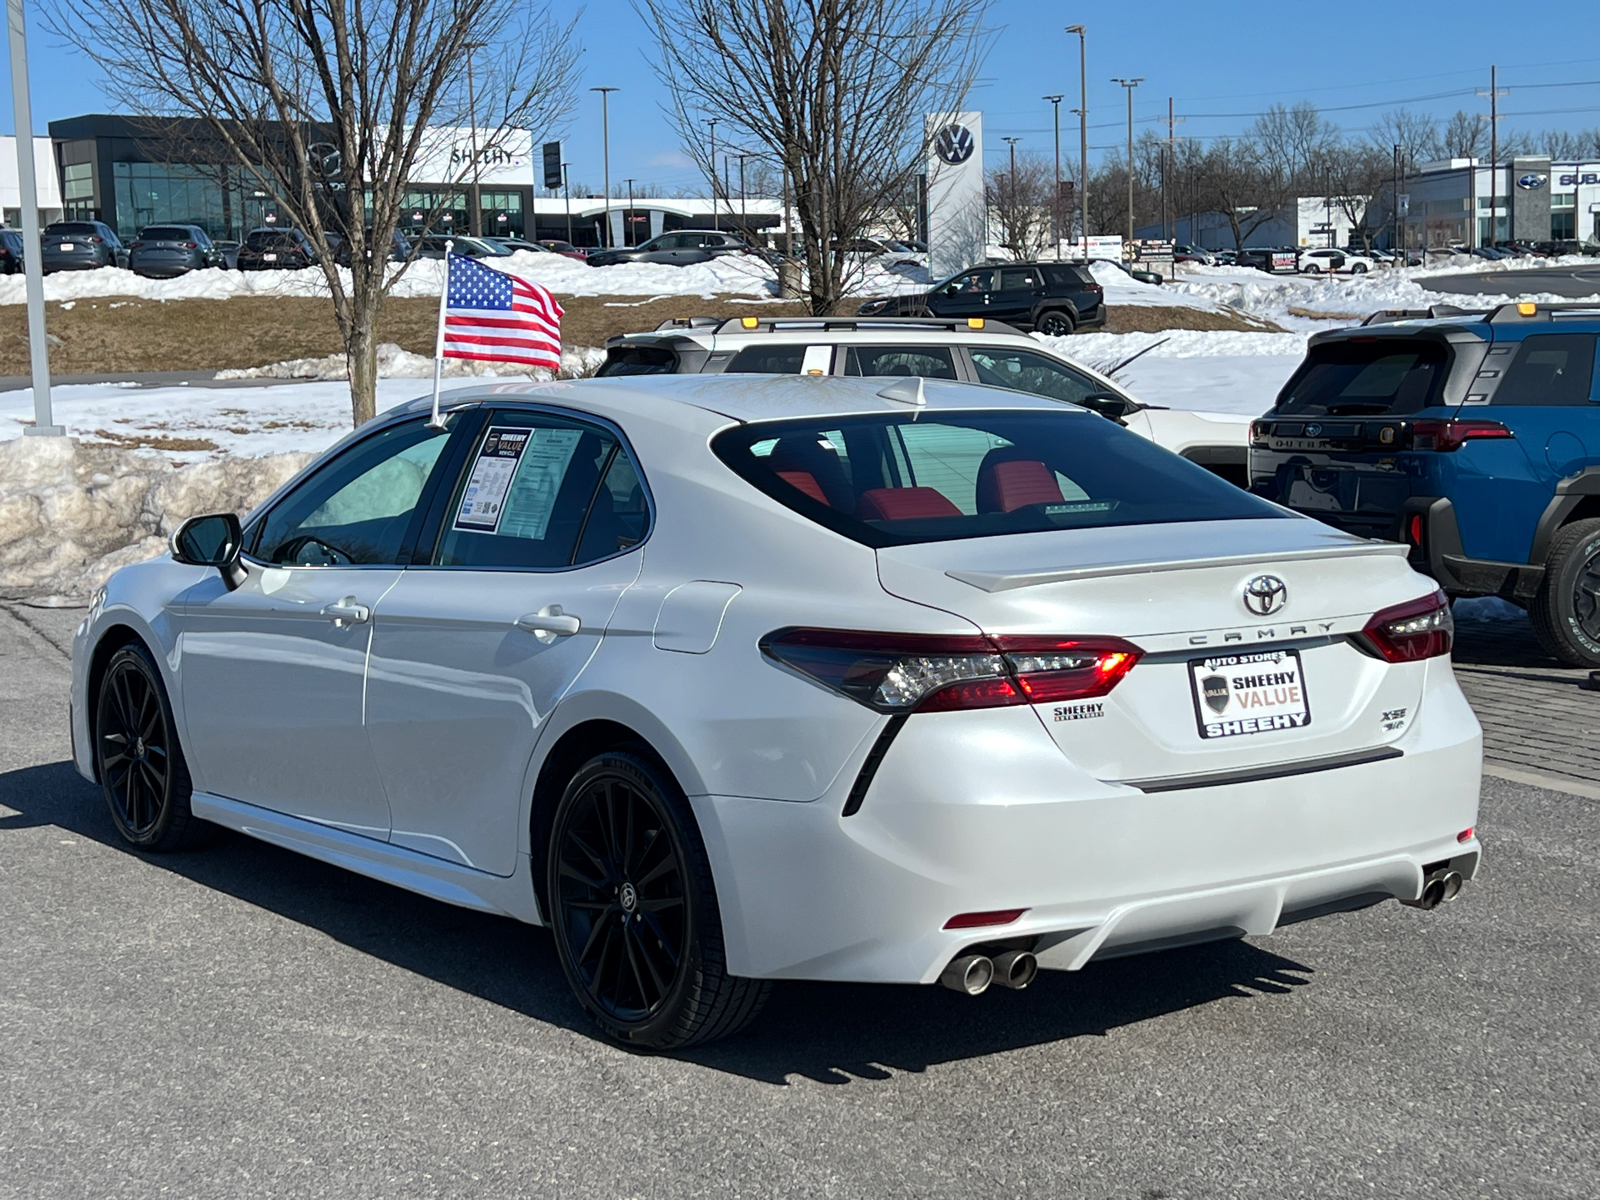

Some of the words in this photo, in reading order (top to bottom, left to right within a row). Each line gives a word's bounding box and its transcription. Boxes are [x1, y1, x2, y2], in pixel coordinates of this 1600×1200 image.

[1272, 258, 1296, 266] GMC
[498, 441, 524, 451] VALUE
[1189, 622, 1335, 645] CAMRY
[1204, 656, 1237, 667] AUTO
[1239, 651, 1287, 664] STORES
[1233, 671, 1295, 689] SHEEHY
[1236, 686, 1300, 709] VALUE
[1054, 703, 1103, 716] SHEEHY
[1380, 708, 1407, 722] XSE
[1206, 712, 1307, 737] SHEEHY
